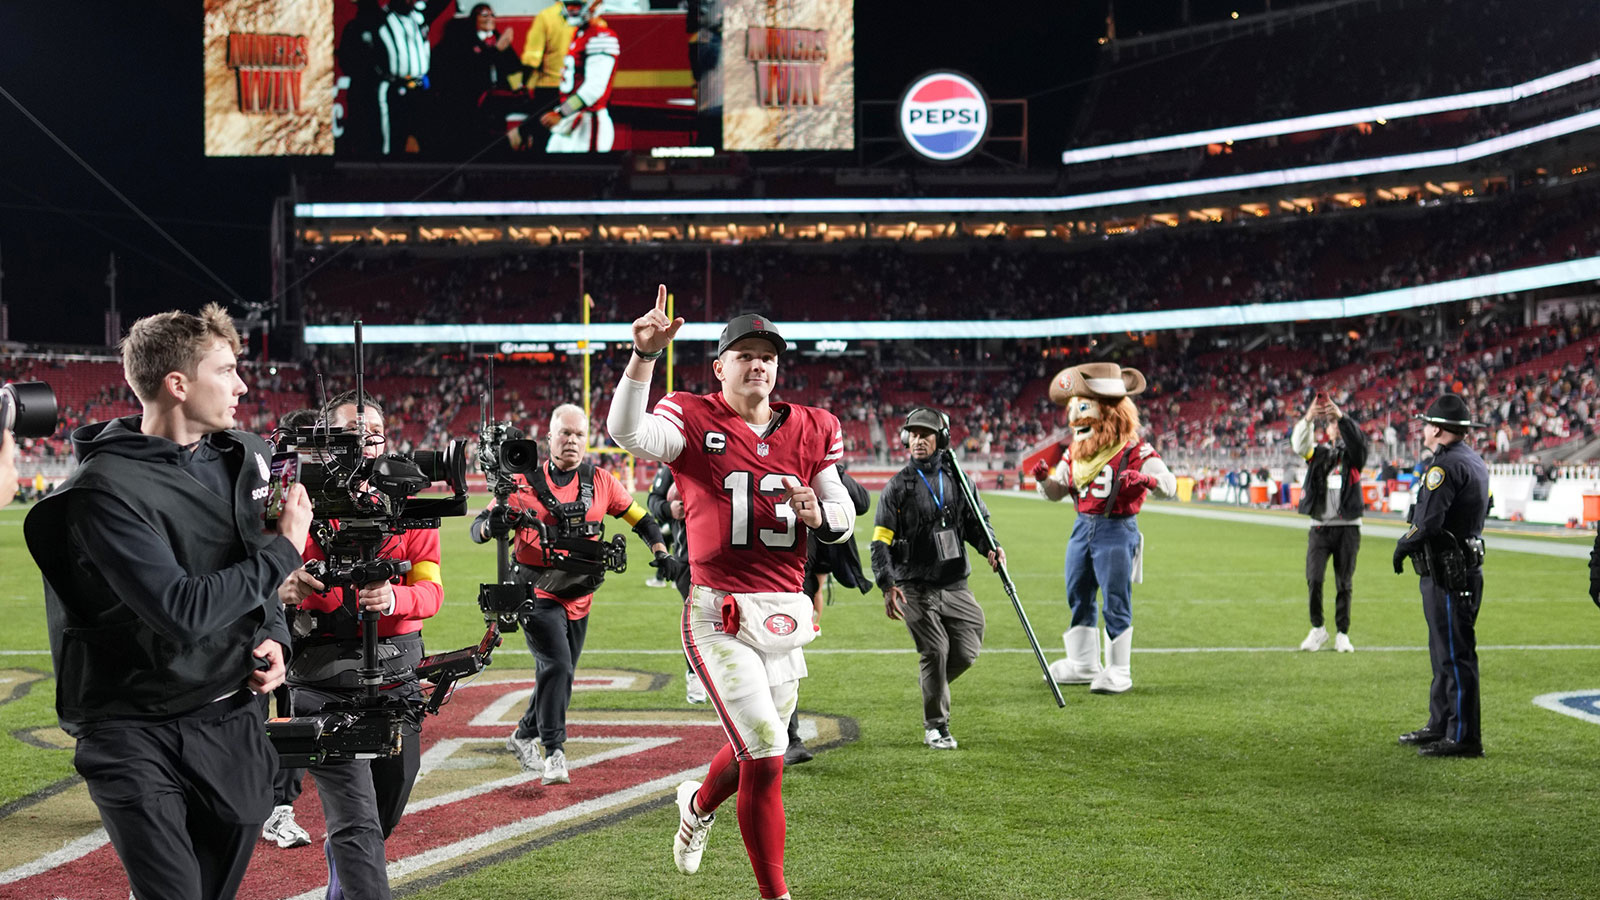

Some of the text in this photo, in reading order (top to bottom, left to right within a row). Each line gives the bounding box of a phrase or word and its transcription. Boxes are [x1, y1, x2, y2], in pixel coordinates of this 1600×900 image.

[237, 69, 302, 114] WIN
[909, 108, 979, 124] PEPSI
[705, 432, 726, 449] C
[724, 471, 802, 549] 13
